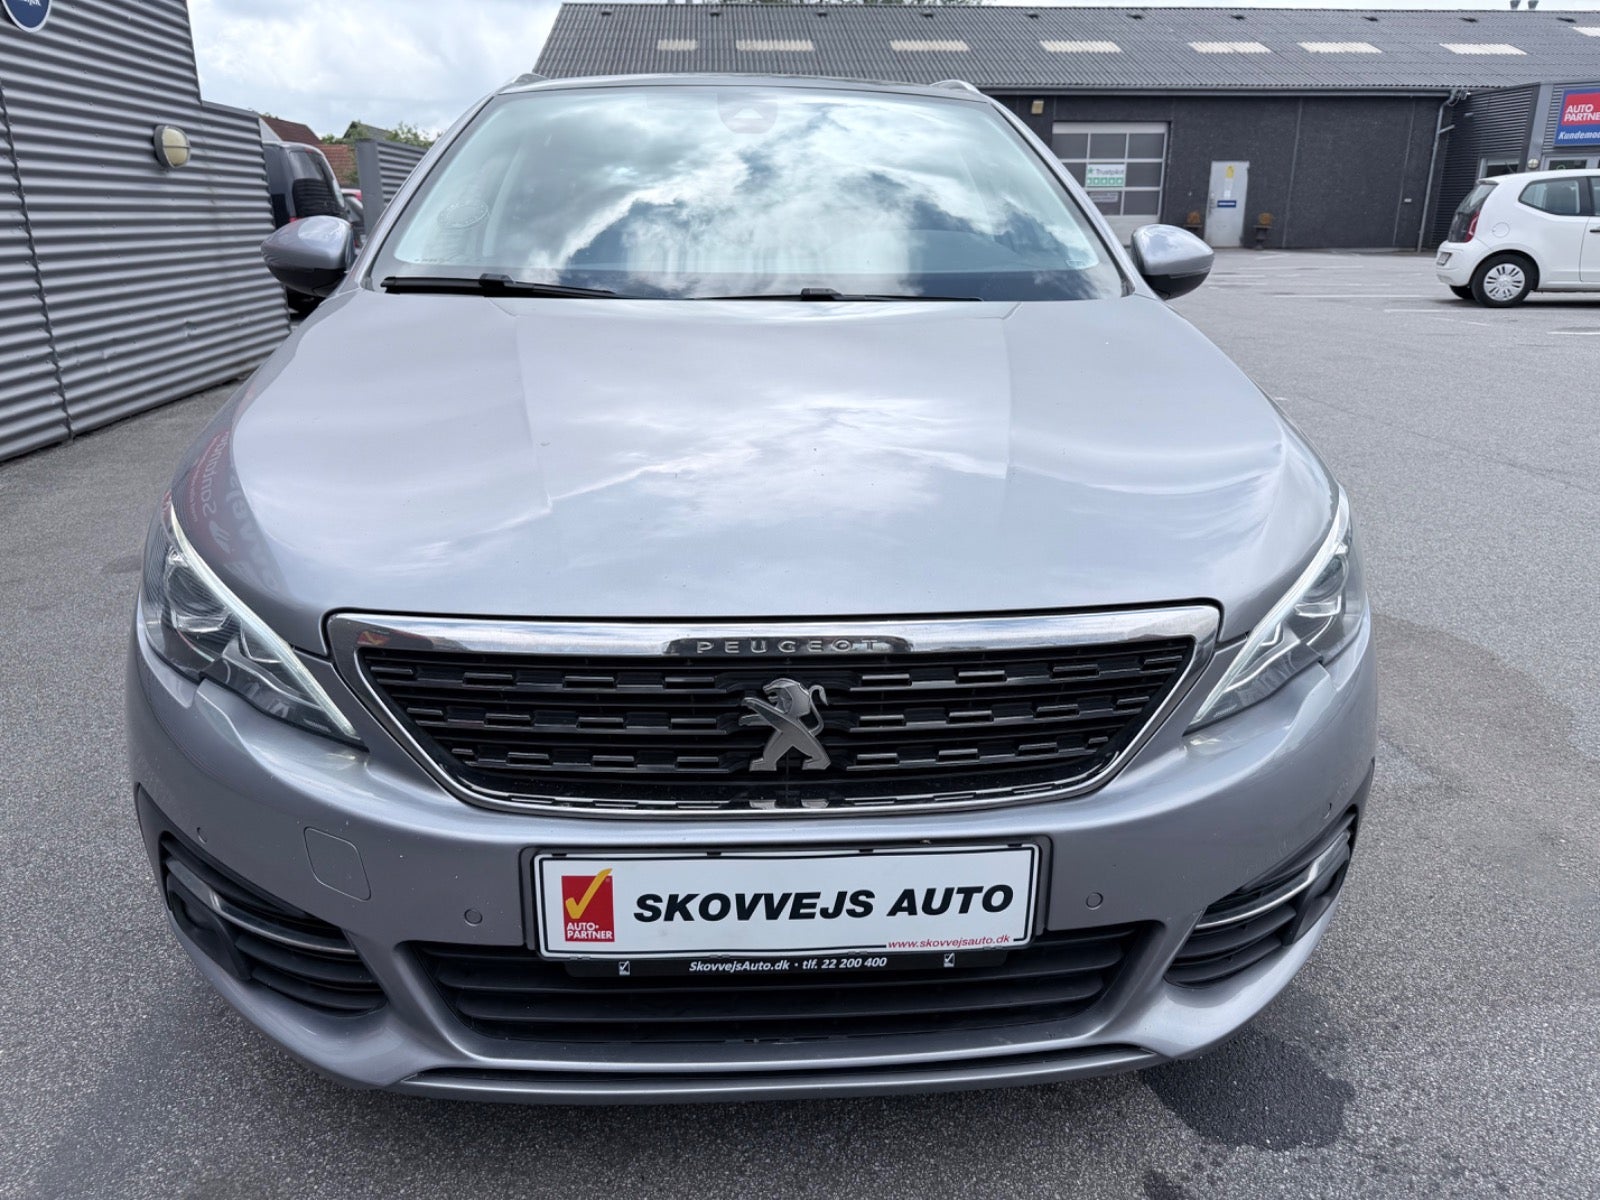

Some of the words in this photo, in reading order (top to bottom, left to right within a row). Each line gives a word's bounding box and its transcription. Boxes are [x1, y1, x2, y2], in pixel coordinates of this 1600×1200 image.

[1566, 104, 1594, 113] AUTO
[697, 640, 878, 654] PEUGEOT
[633, 889, 875, 923] SKOVVEJS
[886, 884, 1014, 917] AUTO
[567, 930, 614, 940] PARTNER
[888, 934, 1010, 948] www.skovvejsauto.dk
[689, 960, 790, 973] SkovvejsAuto.dk
[802, 959, 818, 970] tlf.
[821, 958, 837, 969] 22
[839, 958, 862, 969] 200
[864, 957, 887, 968] 400
